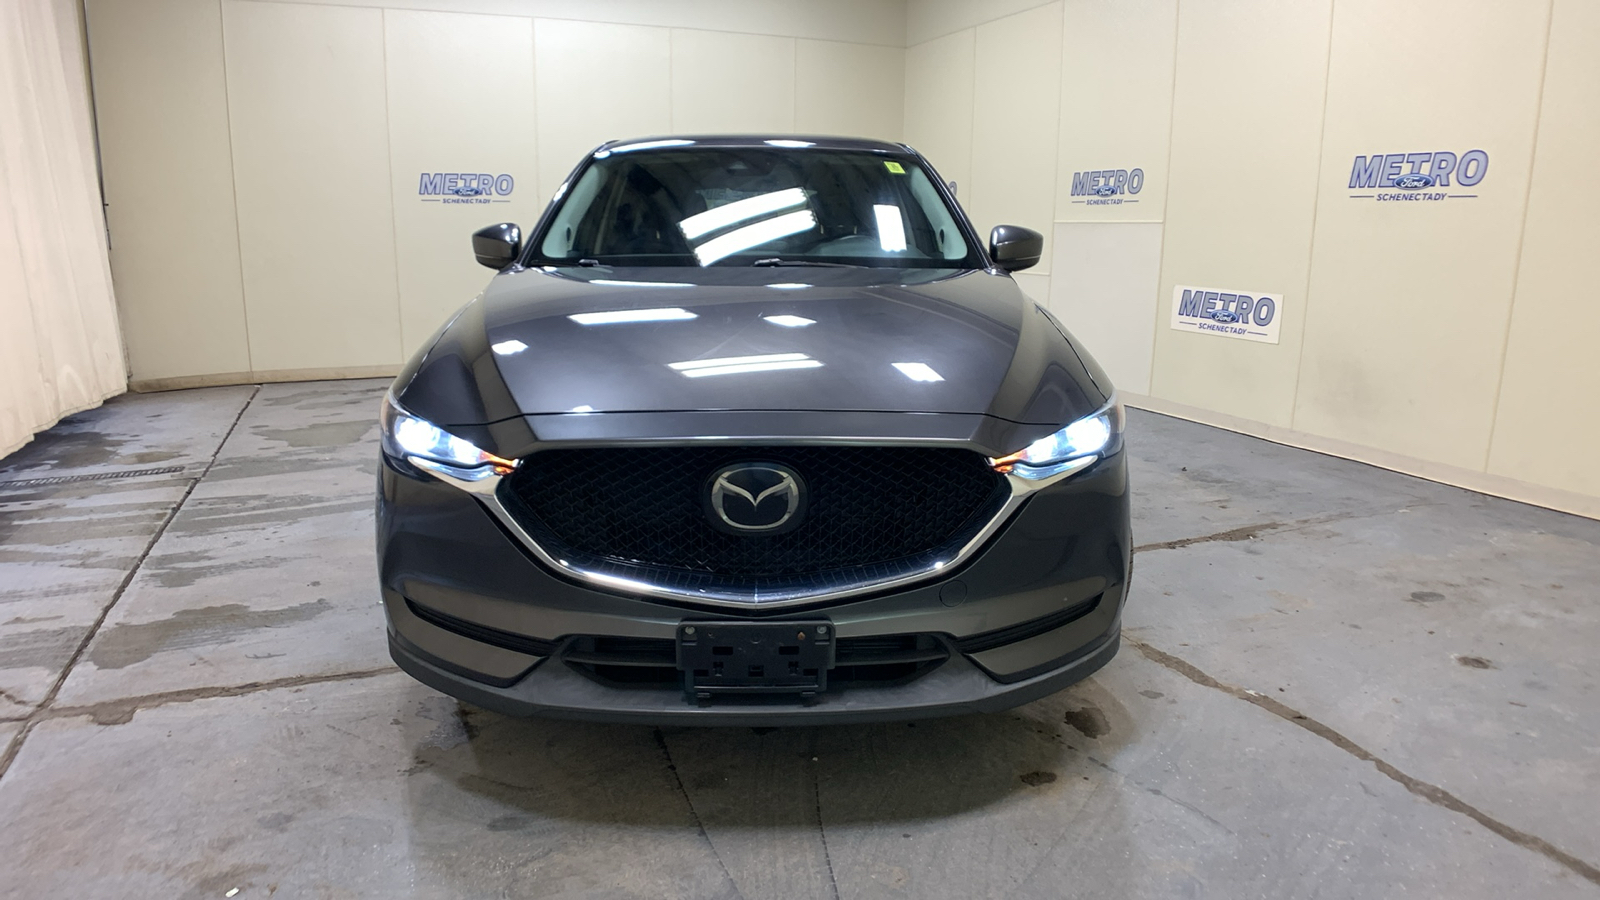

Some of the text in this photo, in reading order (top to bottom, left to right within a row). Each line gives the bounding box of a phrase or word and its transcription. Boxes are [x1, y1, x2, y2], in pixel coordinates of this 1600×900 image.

[1348, 149, 1489, 189] METRO
[418, 173, 514, 196] METRO
[1070, 168, 1144, 196] METRO
[1376, 193, 1447, 201] SCHENECTADY
[1178, 289, 1275, 327] METRO
[1198, 322, 1247, 335] SCHENECTADY
